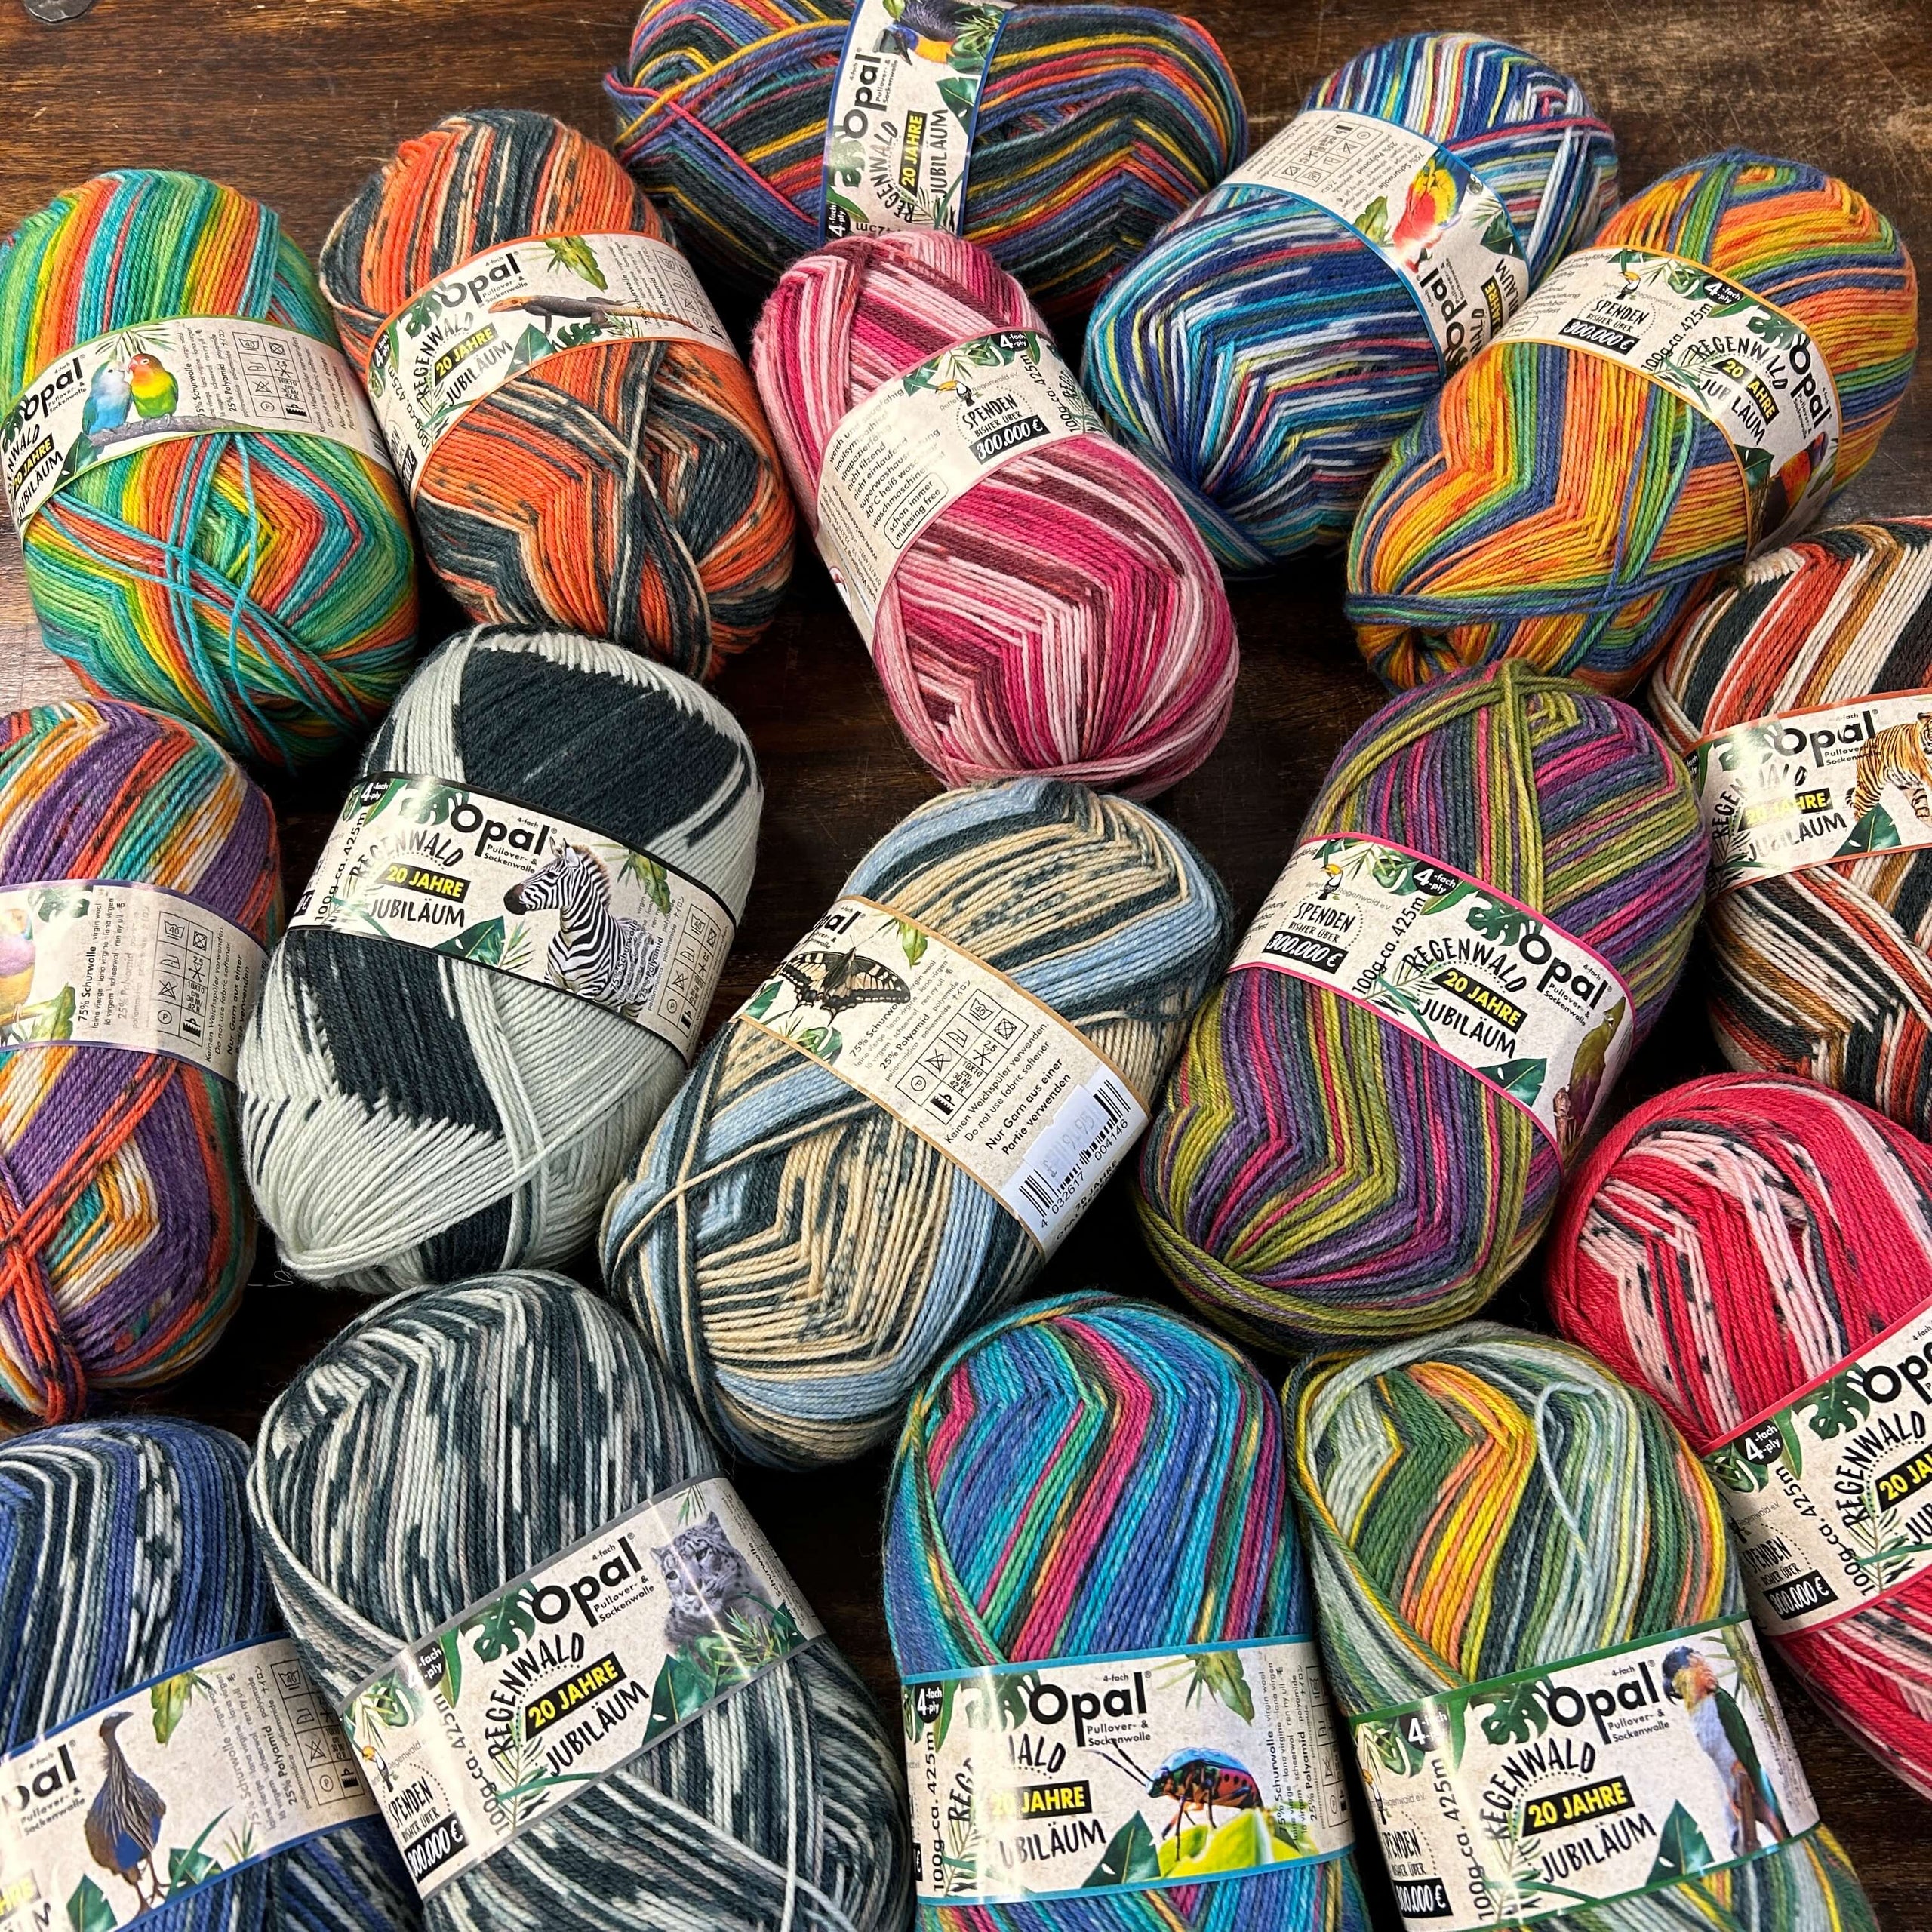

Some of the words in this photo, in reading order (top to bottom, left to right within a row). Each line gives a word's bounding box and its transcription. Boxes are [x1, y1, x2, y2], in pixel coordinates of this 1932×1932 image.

[843, 54, 887, 139] Opal
[875, 67, 891, 102] Pullover-
[883, 60, 898, 103] Sockenwolle
[906, 115, 923, 166] JAHRE
[926, 109, 949, 199] JUBILÄUM
[869, 120, 916, 223] REGENWALD
[900, 168, 915, 187] 20
[441, 252, 522, 308] Opal
[482, 280, 516, 298] Pullover-
[485, 281, 528, 303] Sockenwolle
[1704, 282, 1723, 296] 4
[1420, 268, 1468, 351] Opal
[1586, 313, 1613, 325] BISHER
[1591, 299, 1650, 325] SPENDEN
[436, 357, 451, 377] 20
[454, 328, 494, 363] JAHRE
[1000, 335, 1014, 349] 4
[1562, 321, 1622, 346] 300.000
[1641, 346, 1674, 371] 100g
[1681, 303, 1713, 331] 425m
[220, 363, 232, 395] Polyamid
[413, 312, 474, 403] REGENWALD
[446, 340, 513, 407] JUBILÄUM
[1020, 354, 1045, 386] 425m
[1688, 336, 1788, 389] REGENWALD
[1722, 361, 1744, 378] 20
[23, 357, 84, 422] Opal
[48, 386, 77, 407] Pullover-
[50, 387, 87, 413] Sockenwolle
[185, 363, 202, 401] Schurwolle
[227, 398, 237, 411] 25%
[1789, 344, 1831, 429] Opal
[962, 393, 1018, 430] SPENDEN
[974, 420, 1001, 438] BISHER
[1002, 411, 1023, 423] ÜBER
[1700, 379, 1765, 445] JUBLÄUM
[13, 473, 23, 490] 20
[23, 438, 51, 477] JAHRE
[859, 442, 887, 471] filzend
[977, 422, 1031, 460] 300.000
[17, 451, 63, 518] JUBILÄUM
[854, 478, 867, 501] nicht
[889, 507, 909, 533] schon
[909, 479, 934, 507] immer
[895, 506, 925, 541] mulesing
[924, 488, 940, 506] free
[1773, 710, 1876, 768] Opal
[343, 811, 368, 854] 425m
[450, 804, 550, 857] Opal
[516, 817, 540, 828] 4-fach
[483, 851, 536, 874] Sockenwolle
[486, 844, 529, 862] Pullover-
[386, 866, 407, 884] 20
[409, 870, 465, 898] JAHRE
[370, 897, 466, 928] JUBILÄUM
[1287, 922, 1316, 935] BISHER
[1293, 902, 1356, 933] SPENDEN
[1391, 896, 1426, 937] 425m
[617, 919, 638, 971] Schurwolle
[648, 937, 664, 978] Polyamid
[1266, 934, 1327, 964] 300.000
[1402, 937, 1527, 993] REGENWALD
[82, 946, 97, 998] Schurwolle
[1519, 932, 1609, 1010] Opal
[78, 1001, 90, 1021] 75%
[921, 1004, 952, 1038] poliammide
[1444, 971, 1467, 992] 20
[1467, 985, 1522, 1028] JAHRE
[1543, 990, 1586, 1027] Sockenwolle
[849, 1038, 869, 1057] 75%
[880, 1049, 898, 1070] 25%
[896, 1013, 931, 1050] Polyamid
[1418, 998, 1517, 1059] JUBILÄUM
[945, 1115, 972, 1143] Keinen
[968, 1066, 1011, 1113] Weichspüler
[1010, 1023, 1049, 1066] verwenden.
[964, 1129, 978, 1141] Do
[978, 1113, 992, 1131] not
[990, 1100, 1004, 1113] use
[1001, 1073, 1024, 1097] fabric
[1023, 1041, 1051, 1075] softener.
[986, 1129, 1006, 1149] Nur
[1003, 1103, 1027, 1128] Garn
[1026, 1084, 1042, 1103] aus
[1041, 1058, 1063, 1084] einer
[1001, 1128, 1028, 1155] Partie
[1026, 1073, 1072, 1126] verwenden
[1051, 1171, 1085, 1214] 032617
[1094, 1119, 1128, 1161] 004146
[1744, 1436, 1764, 1462] 4
[1755, 1423, 1779, 1442] -fach
[1761, 1438, 1782, 1456] -ply
[1775, 1465, 1818, 1518] 425m
[1835, 1411, 1925, 1529] REGENWALD
[1879, 1474, 1909, 1500] 20
[591, 1543, 617, 1561] 4-fach
[1742, 1536, 1792, 1574] SPENDEN
[1838, 1546, 1876, 1597] 100g
[531, 1536, 643, 1628] Opal
[592, 1582, 638, 1612] Pullover-
[598, 1585, 656, 1623] Sockenwolle
[527, 1700, 558, 1729] 20
[558, 1659, 619, 1711] JAHRE
[1103, 1673, 1129, 1682] 4-fach
[1611, 1666, 1635, 1677] 4-fach
[483, 1632, 585, 1760] REGENWALD
[917, 1688, 928, 1715] 4
[926, 1687, 943, 1699] -fach
[1029, 1672, 1148, 1748] Opal
[1292, 1675, 1303, 1722] polyamide
[1547, 1662, 1660, 1746] Opal
[269, 1700, 291, 1747] poliammide
[546, 1680, 650, 1777] JUBILÄUM
[1087, 1723, 1138, 1734] Pullover-
[1140, 1721, 1149, 1729] &
[1088, 1733, 1152, 1746] Sockenwolle
[1407, 1718, 1426, 1744] 4
[1607, 1713, 1654, 1730] Pullover-
[1611, 1721, 1670, 1743] Sockenwolle
[265, 1725, 287, 1777] Polyamid
[924, 1730, 936, 1795] 425m
[1266, 1730, 1283, 1802] Schurwolle
[1297, 1731, 1312, 1789] Polyamid
[389, 1776, 434, 1829] SPENDEN
[479, 1779, 513, 1835] 100g
[1020, 1786, 1086, 1813] JAHRE
[1309, 1792, 1318, 1821] 25%
[1431, 1758, 1459, 1822] 425m
[1480, 1737, 1596, 1840] REGENWALD
[1528, 1801, 1558, 1828] 20
[1561, 1782, 1628, 1820] JAHRE
[931, 1838, 945, 1892] 100g
[998, 1818, 1106, 1869] UBILÄUM
[1541, 1812, 1657, 1884] JUBILÄUM
